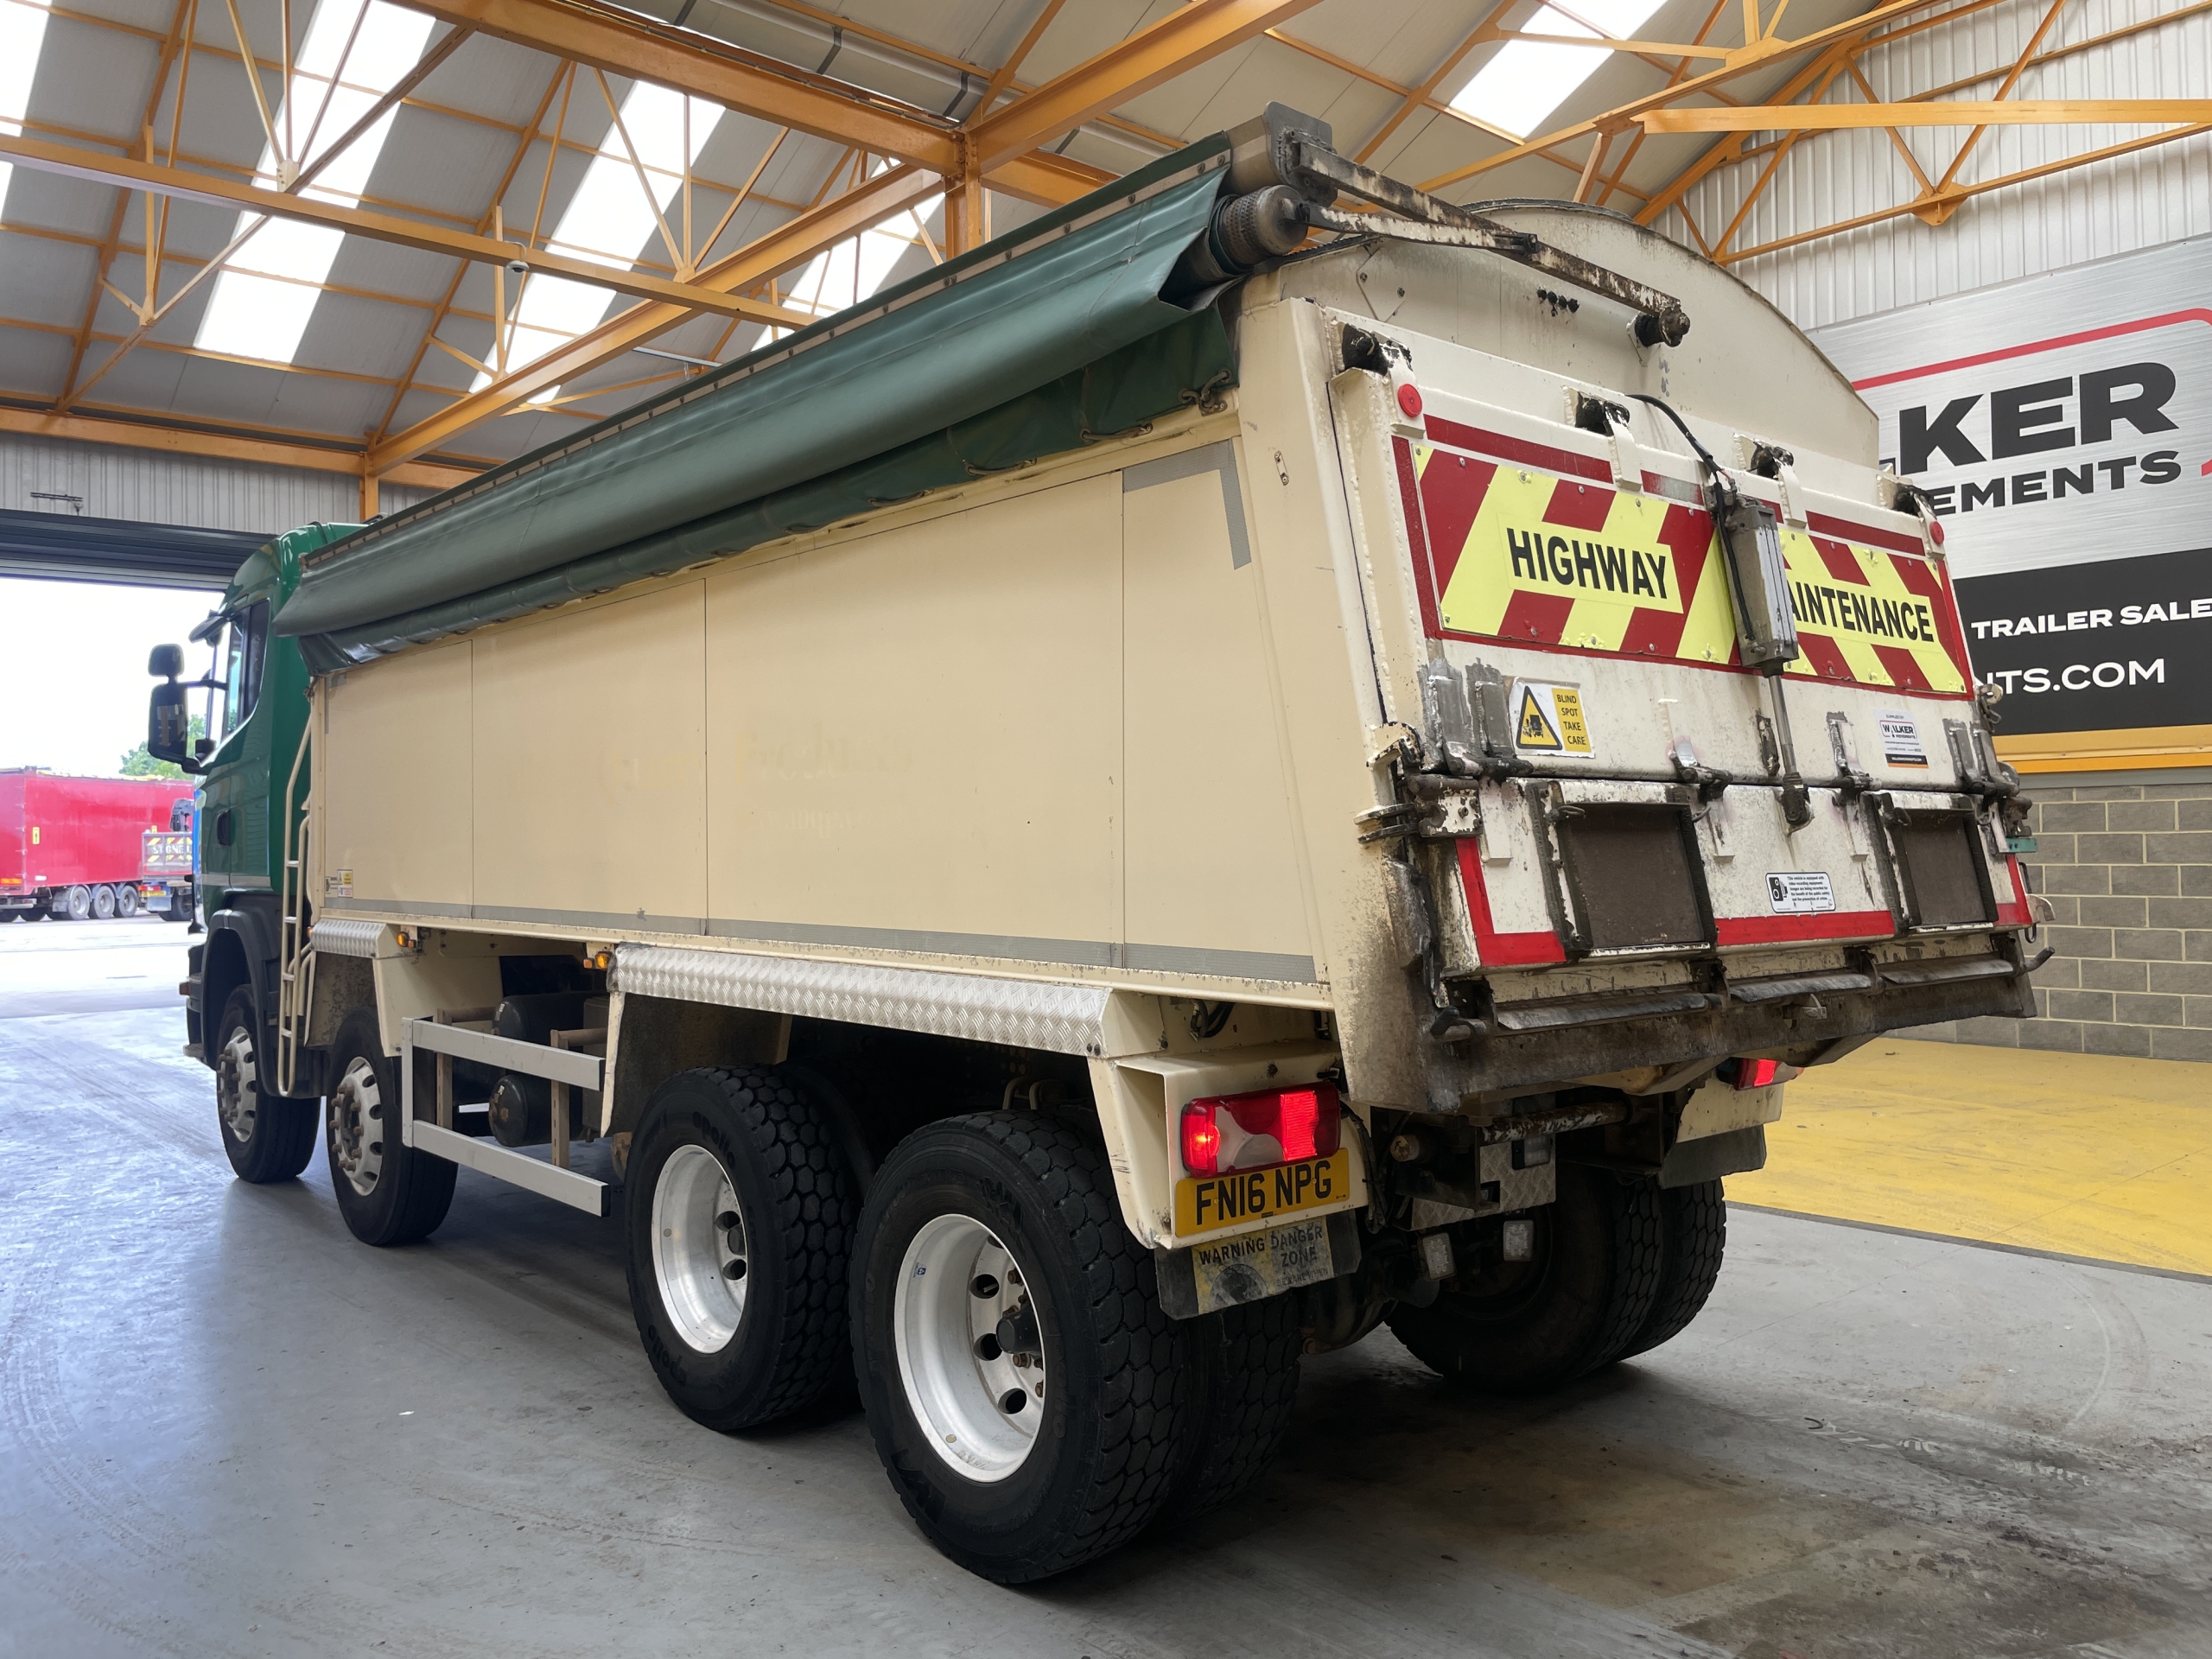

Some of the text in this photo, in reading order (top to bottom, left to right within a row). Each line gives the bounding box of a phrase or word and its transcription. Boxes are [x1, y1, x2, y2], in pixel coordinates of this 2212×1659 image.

[1880, 362, 2180, 476] KER
[1926, 449, 2182, 517] EMENTS
[1506, 527, 1668, 600] HIGHWAY
[1786, 579, 1935, 643] AINTENANCE
[1971, 598, 2212, 639] TRAILER SALE
[1556, 694, 1577, 703] BLIND
[1560, 708, 1578, 717] SPOT
[1562, 721, 1582, 731] TAKE
[1567, 735, 1586, 745] CARE
[1197, 1160, 1332, 1226] FN16 NPG
[1198, 1237, 1265, 1265] WARNING
[1270, 1225, 1323, 1249] DANGER
[1281, 1245, 1318, 1268] ZONE
